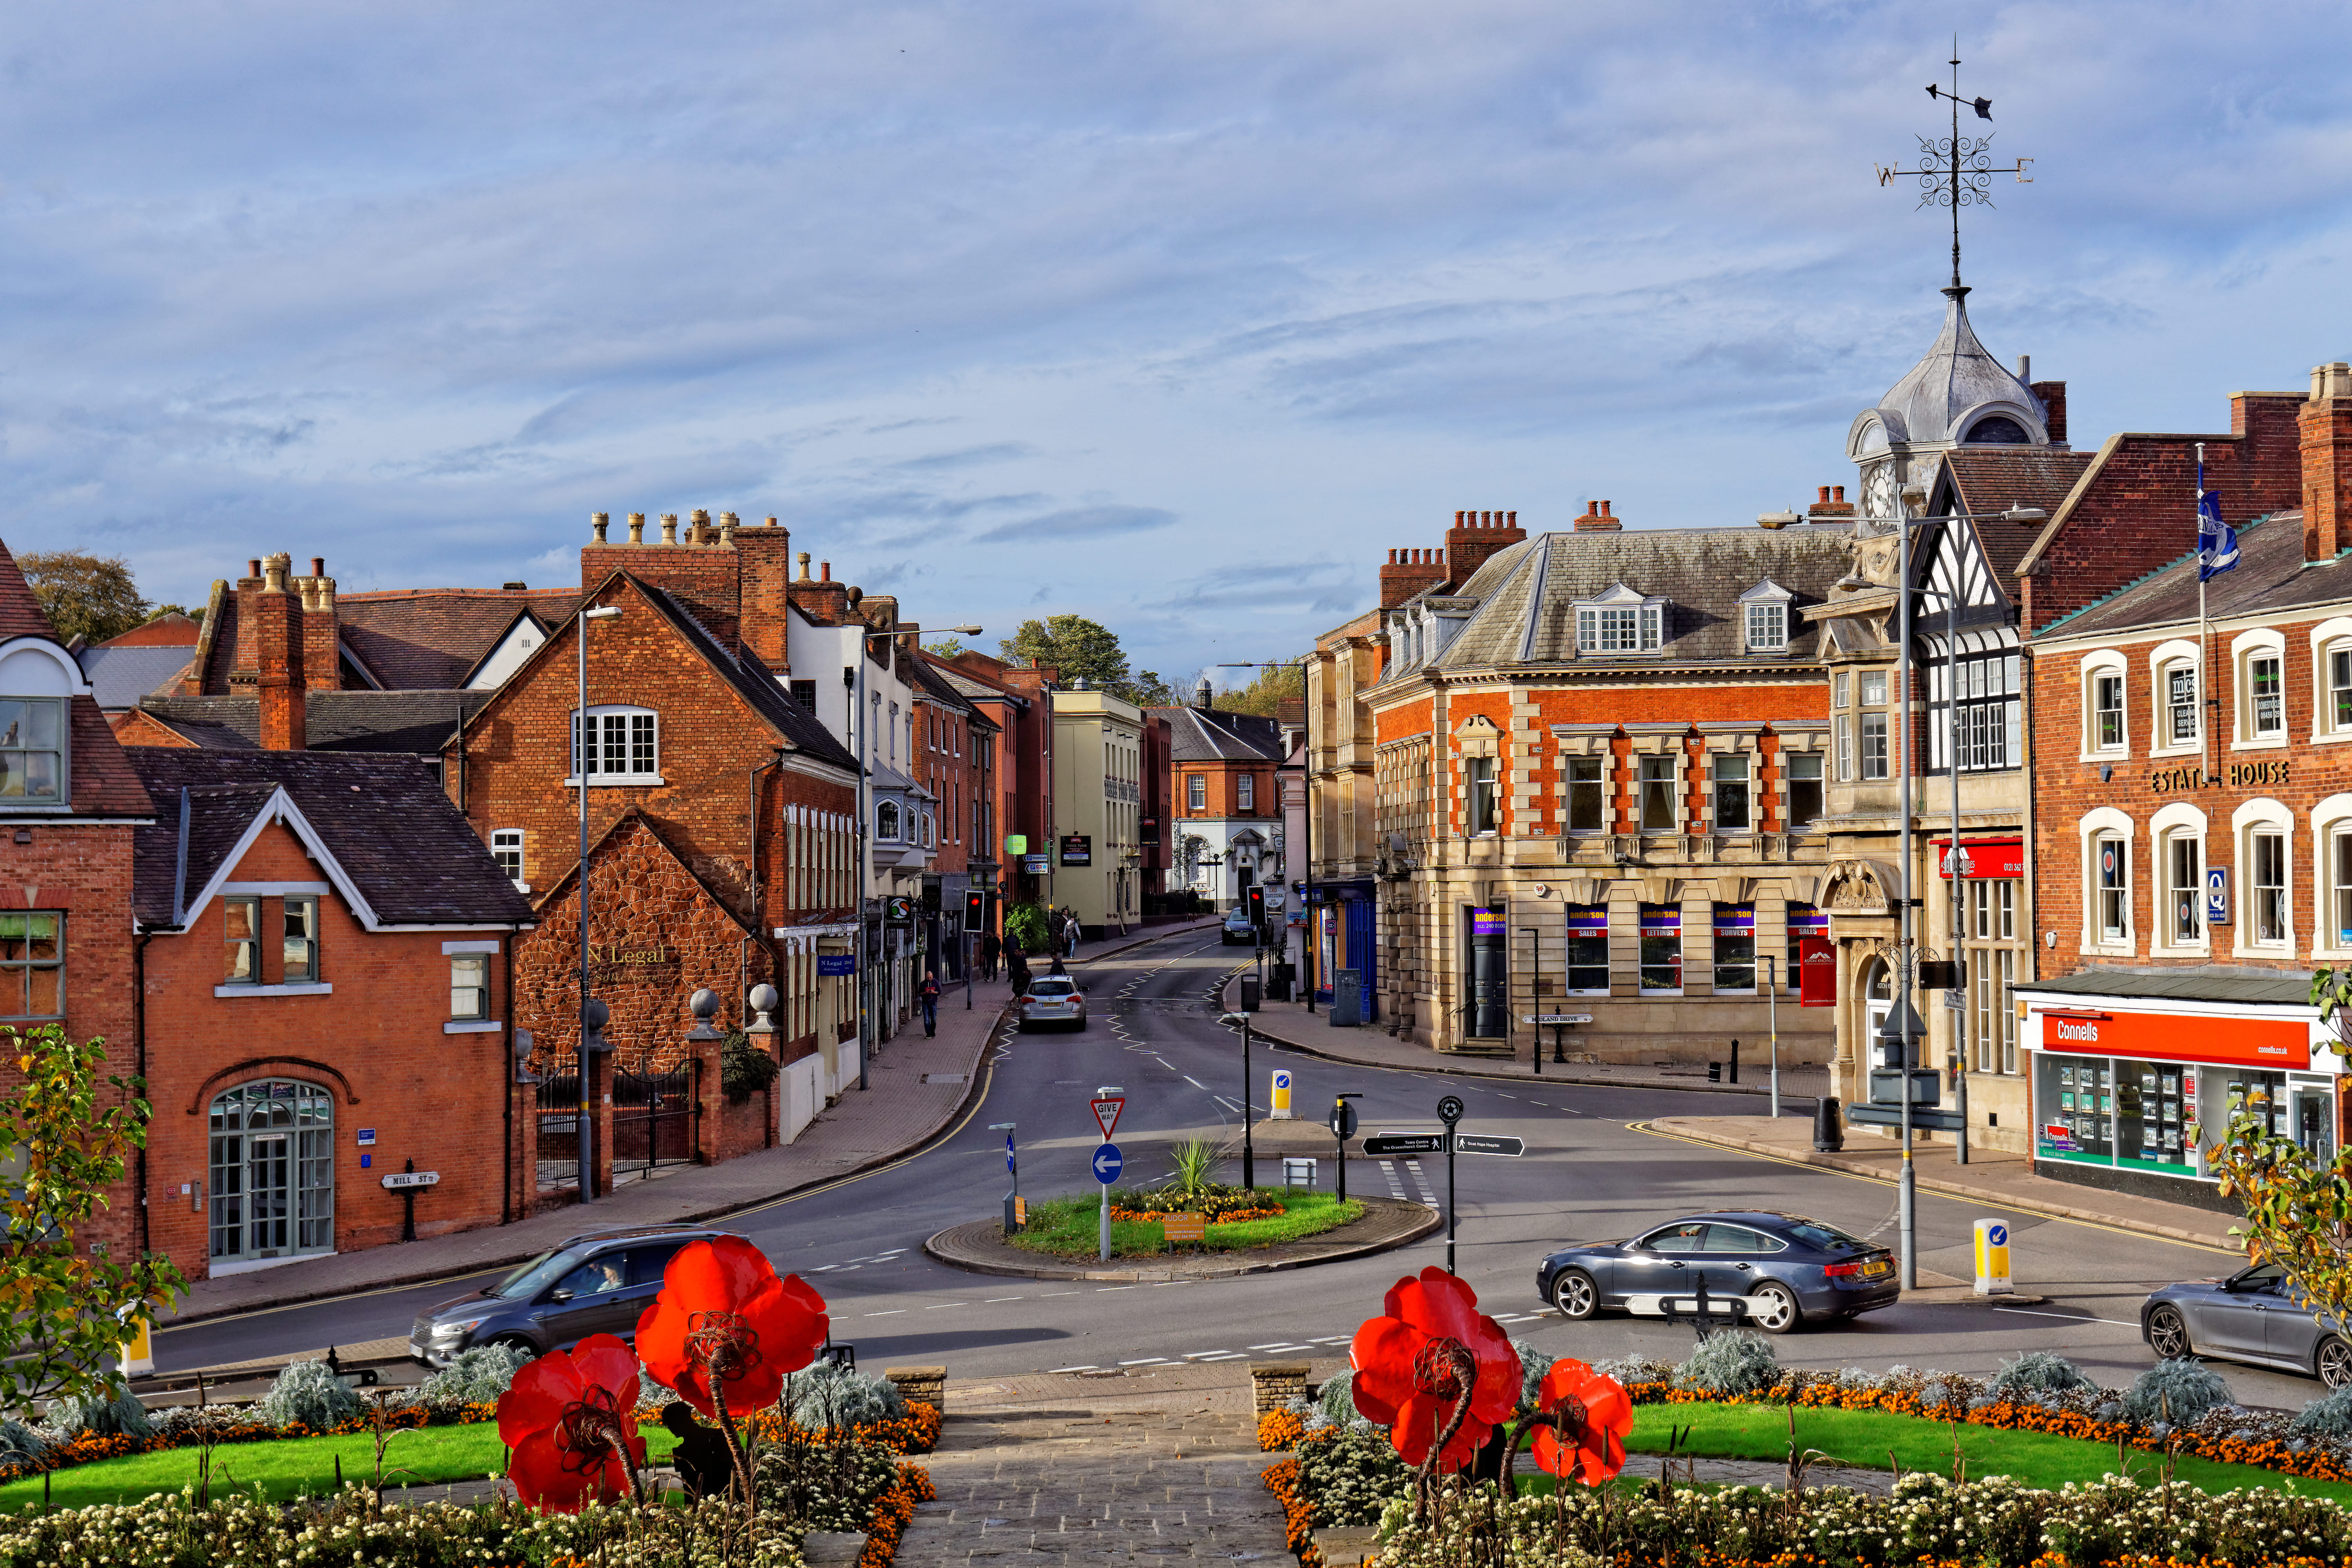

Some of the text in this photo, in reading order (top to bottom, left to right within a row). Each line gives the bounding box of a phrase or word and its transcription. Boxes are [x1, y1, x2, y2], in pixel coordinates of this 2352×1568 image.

[1874, 161, 1898, 186] W
[2016, 158, 2034, 183] E
[2230, 761, 2289, 786] HOUSE
[1104, 780, 1139, 802] THREE TUNS HOTEL
[2004, 863, 2013, 871] 0121
[1475, 912, 1506, 922] anderso
[1570, 911, 1605, 919] anderson
[588, 946, 666, 966] N Legal
[595, 972, 657, 981] Solicitors
[2058, 1020, 2098, 1042] Connells
[2258, 1046, 2287, 1054] connells.co.uk
[1098, 1103, 1117, 1112] GIVE
